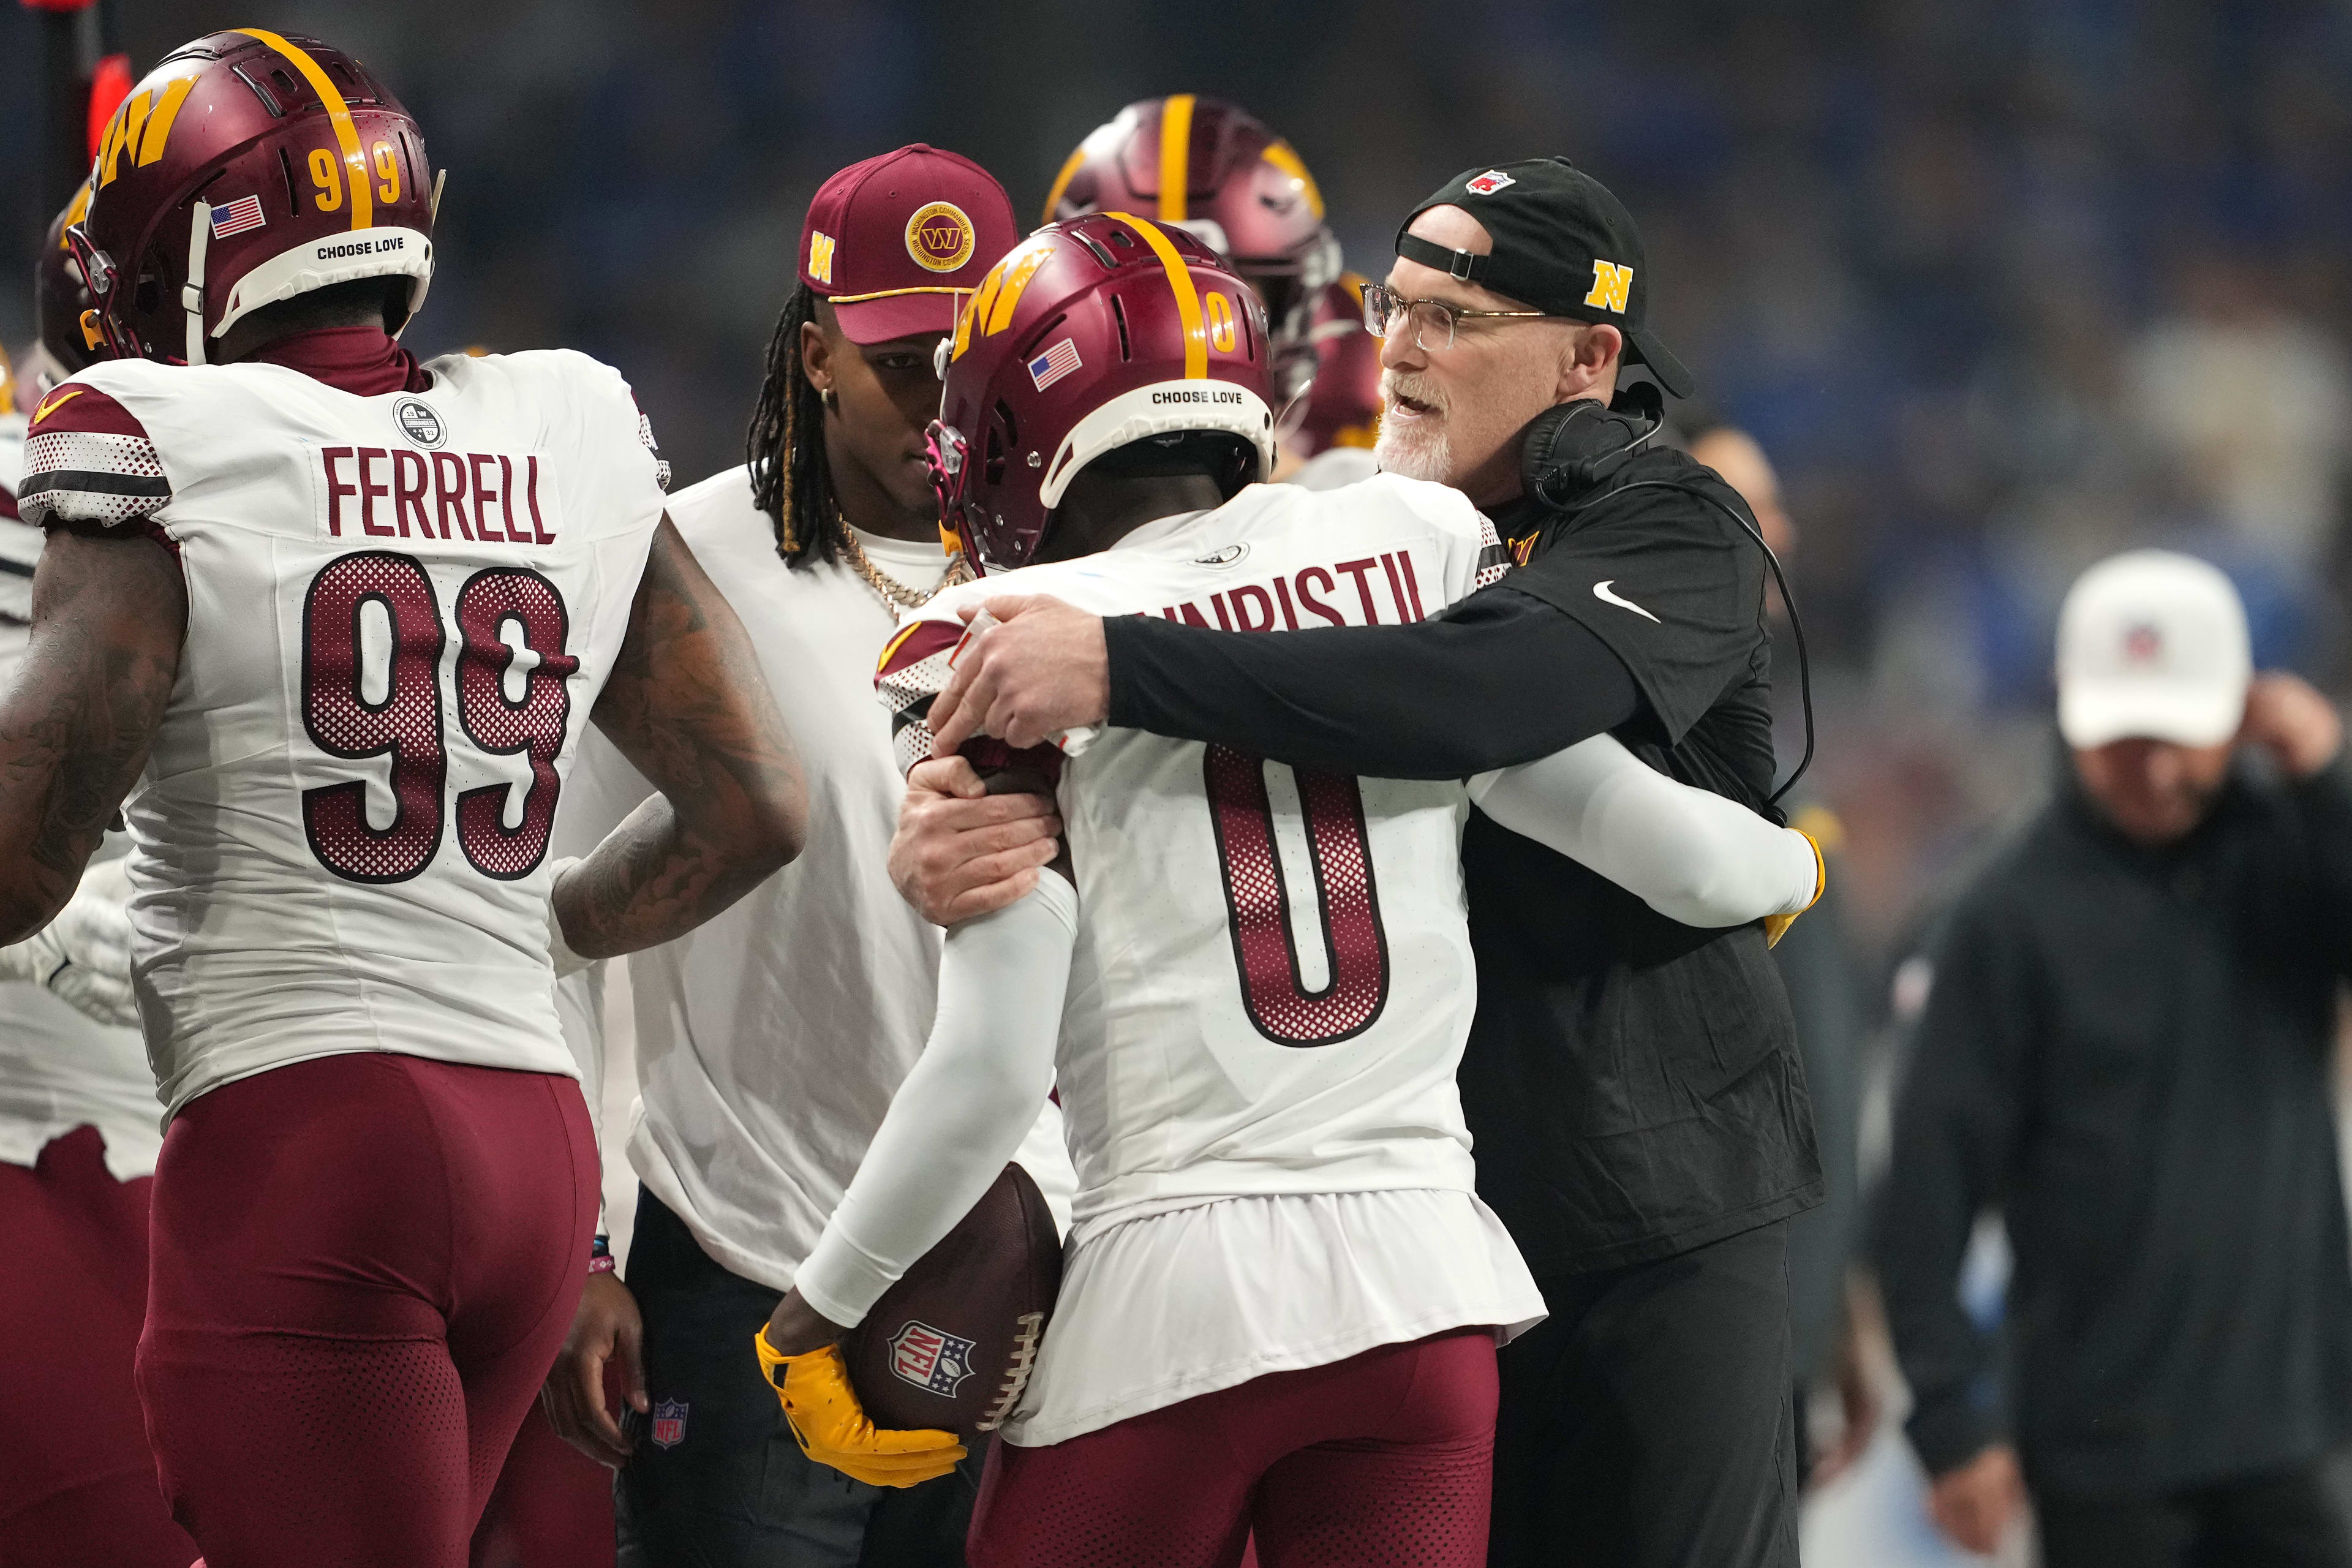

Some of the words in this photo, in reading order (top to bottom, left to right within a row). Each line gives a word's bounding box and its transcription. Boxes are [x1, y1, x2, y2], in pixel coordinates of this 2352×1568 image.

[911, 207, 938, 236] WASHINGTON
[939, 207, 970, 235] COMMANDERS
[317, 242, 372, 260] CHOOSE
[375, 237, 404, 252] LOVE
[911, 239, 941, 266] WASHINGTON
[1583, 259, 1633, 315] N
[1152, 391, 1208, 404] CHOOSE
[1213, 391, 1242, 404] LOVE
[322, 447, 557, 545] FERRELL
[301, 551, 580, 884] 99
[897, 1328, 942, 1378] NFL
[656, 1420, 681, 1442] NFL
